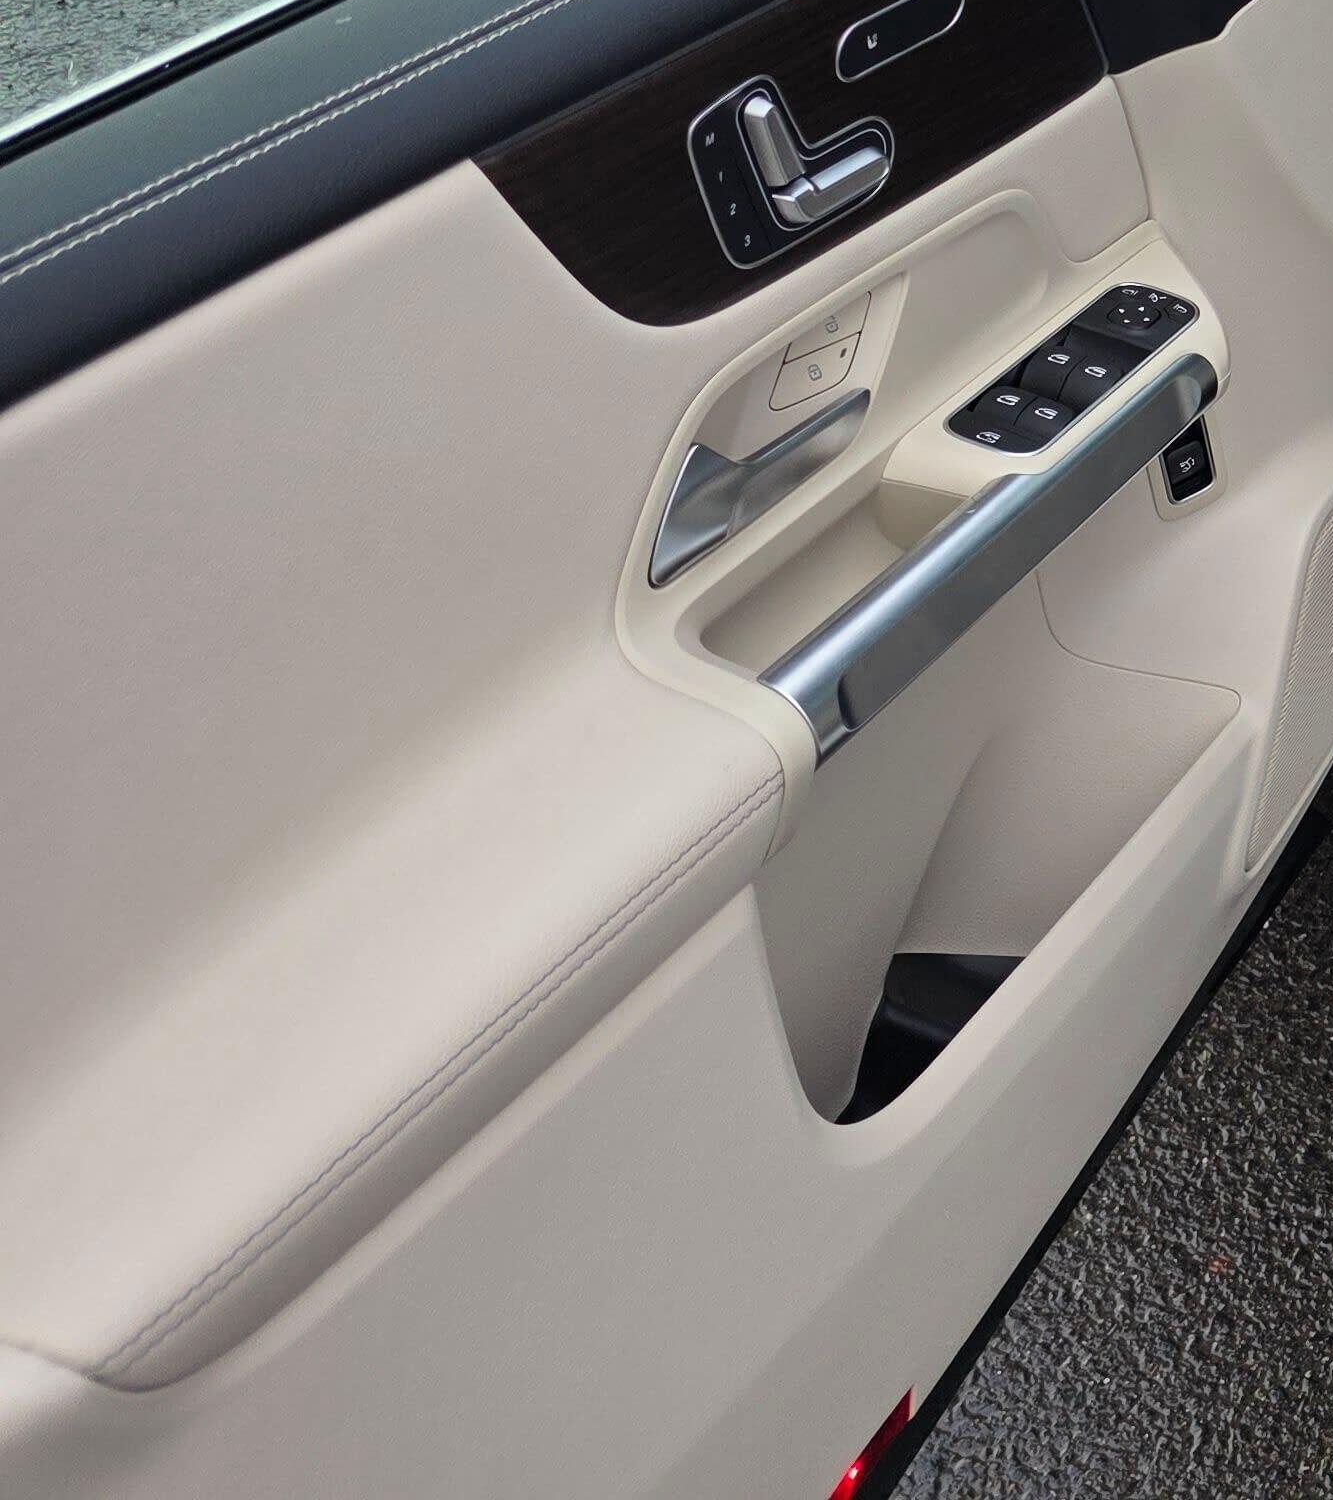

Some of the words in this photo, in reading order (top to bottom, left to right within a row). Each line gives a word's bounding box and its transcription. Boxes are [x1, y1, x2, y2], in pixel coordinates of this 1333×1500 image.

[705, 132, 715, 147] M
[718, 171, 724, 183] 1
[730, 203, 736, 215] 2
[744, 235, 751, 247] 3
